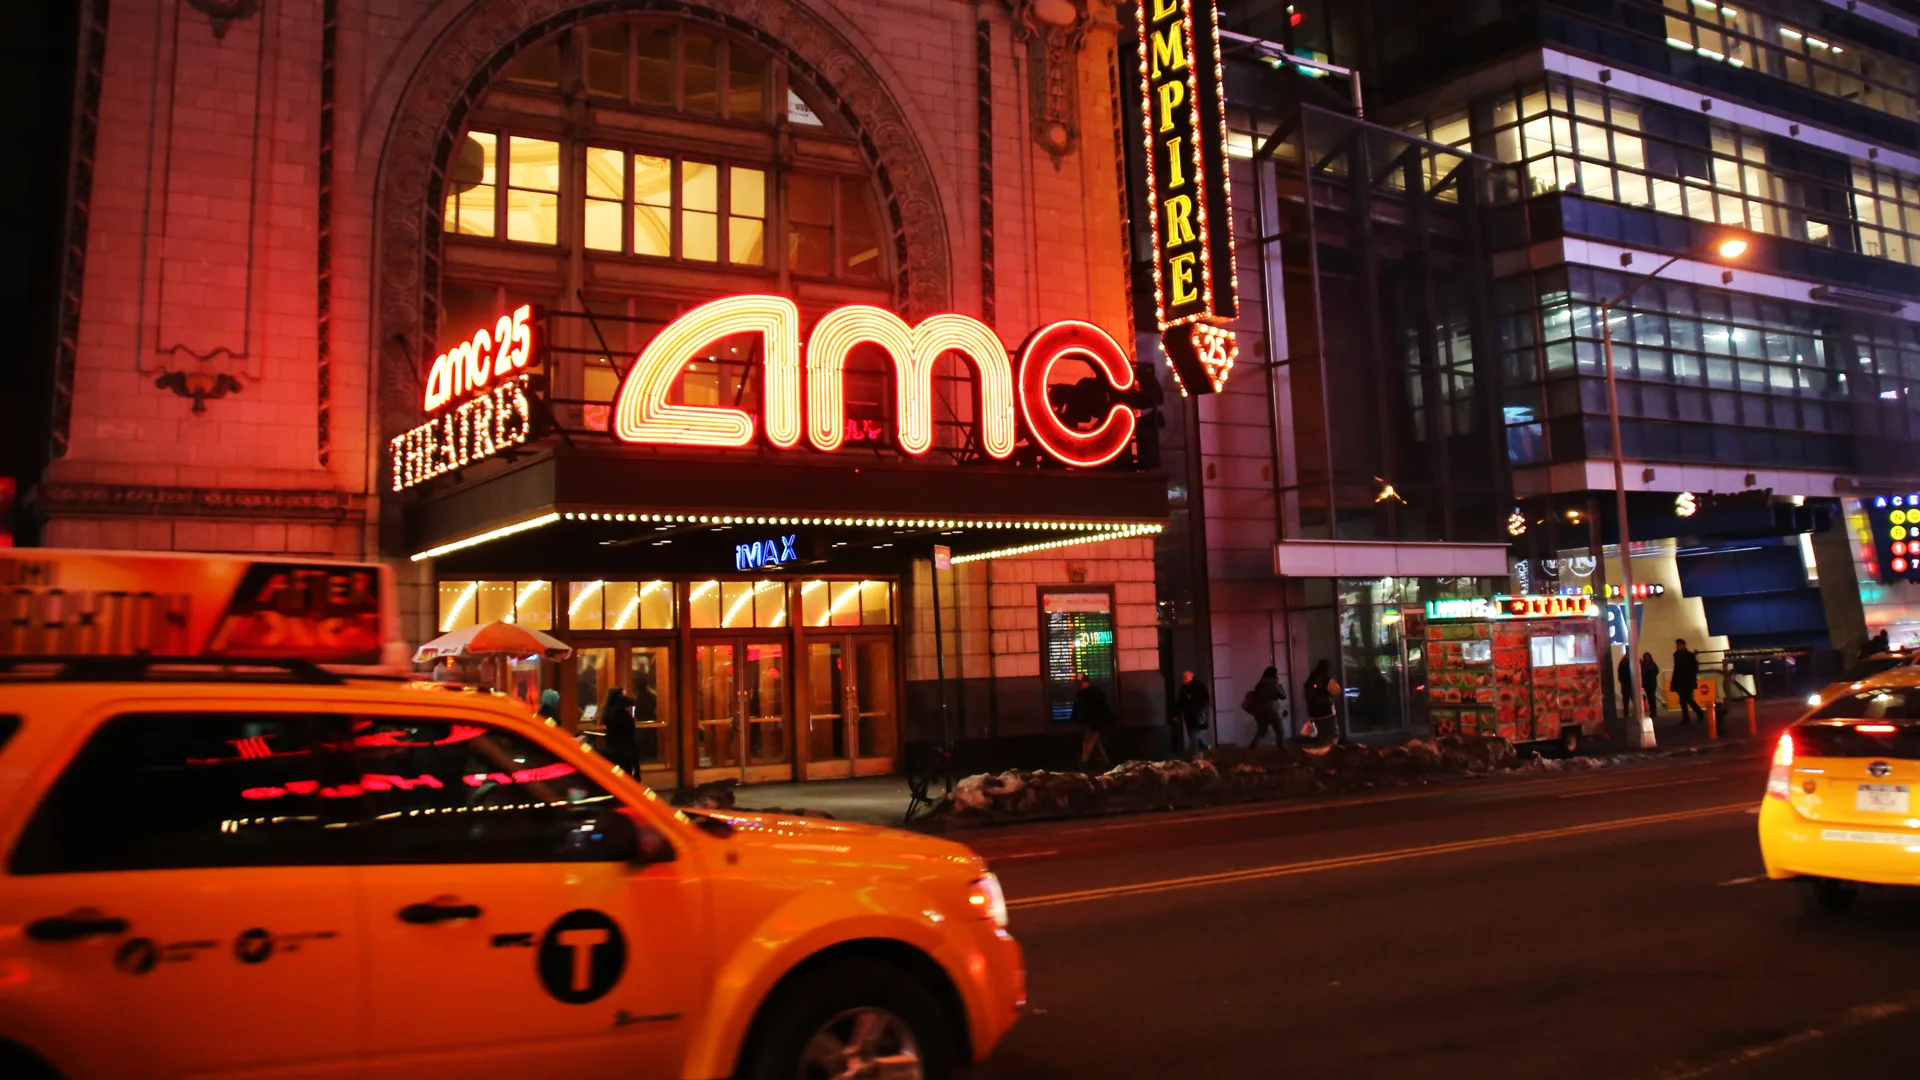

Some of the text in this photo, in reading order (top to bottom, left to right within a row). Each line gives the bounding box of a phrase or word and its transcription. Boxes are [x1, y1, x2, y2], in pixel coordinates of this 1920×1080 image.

[494, 304, 531, 376] 25
[1204, 334, 1226, 368] 25
[390, 373, 530, 491] THEATRES
[556, 928, 610, 992] T
